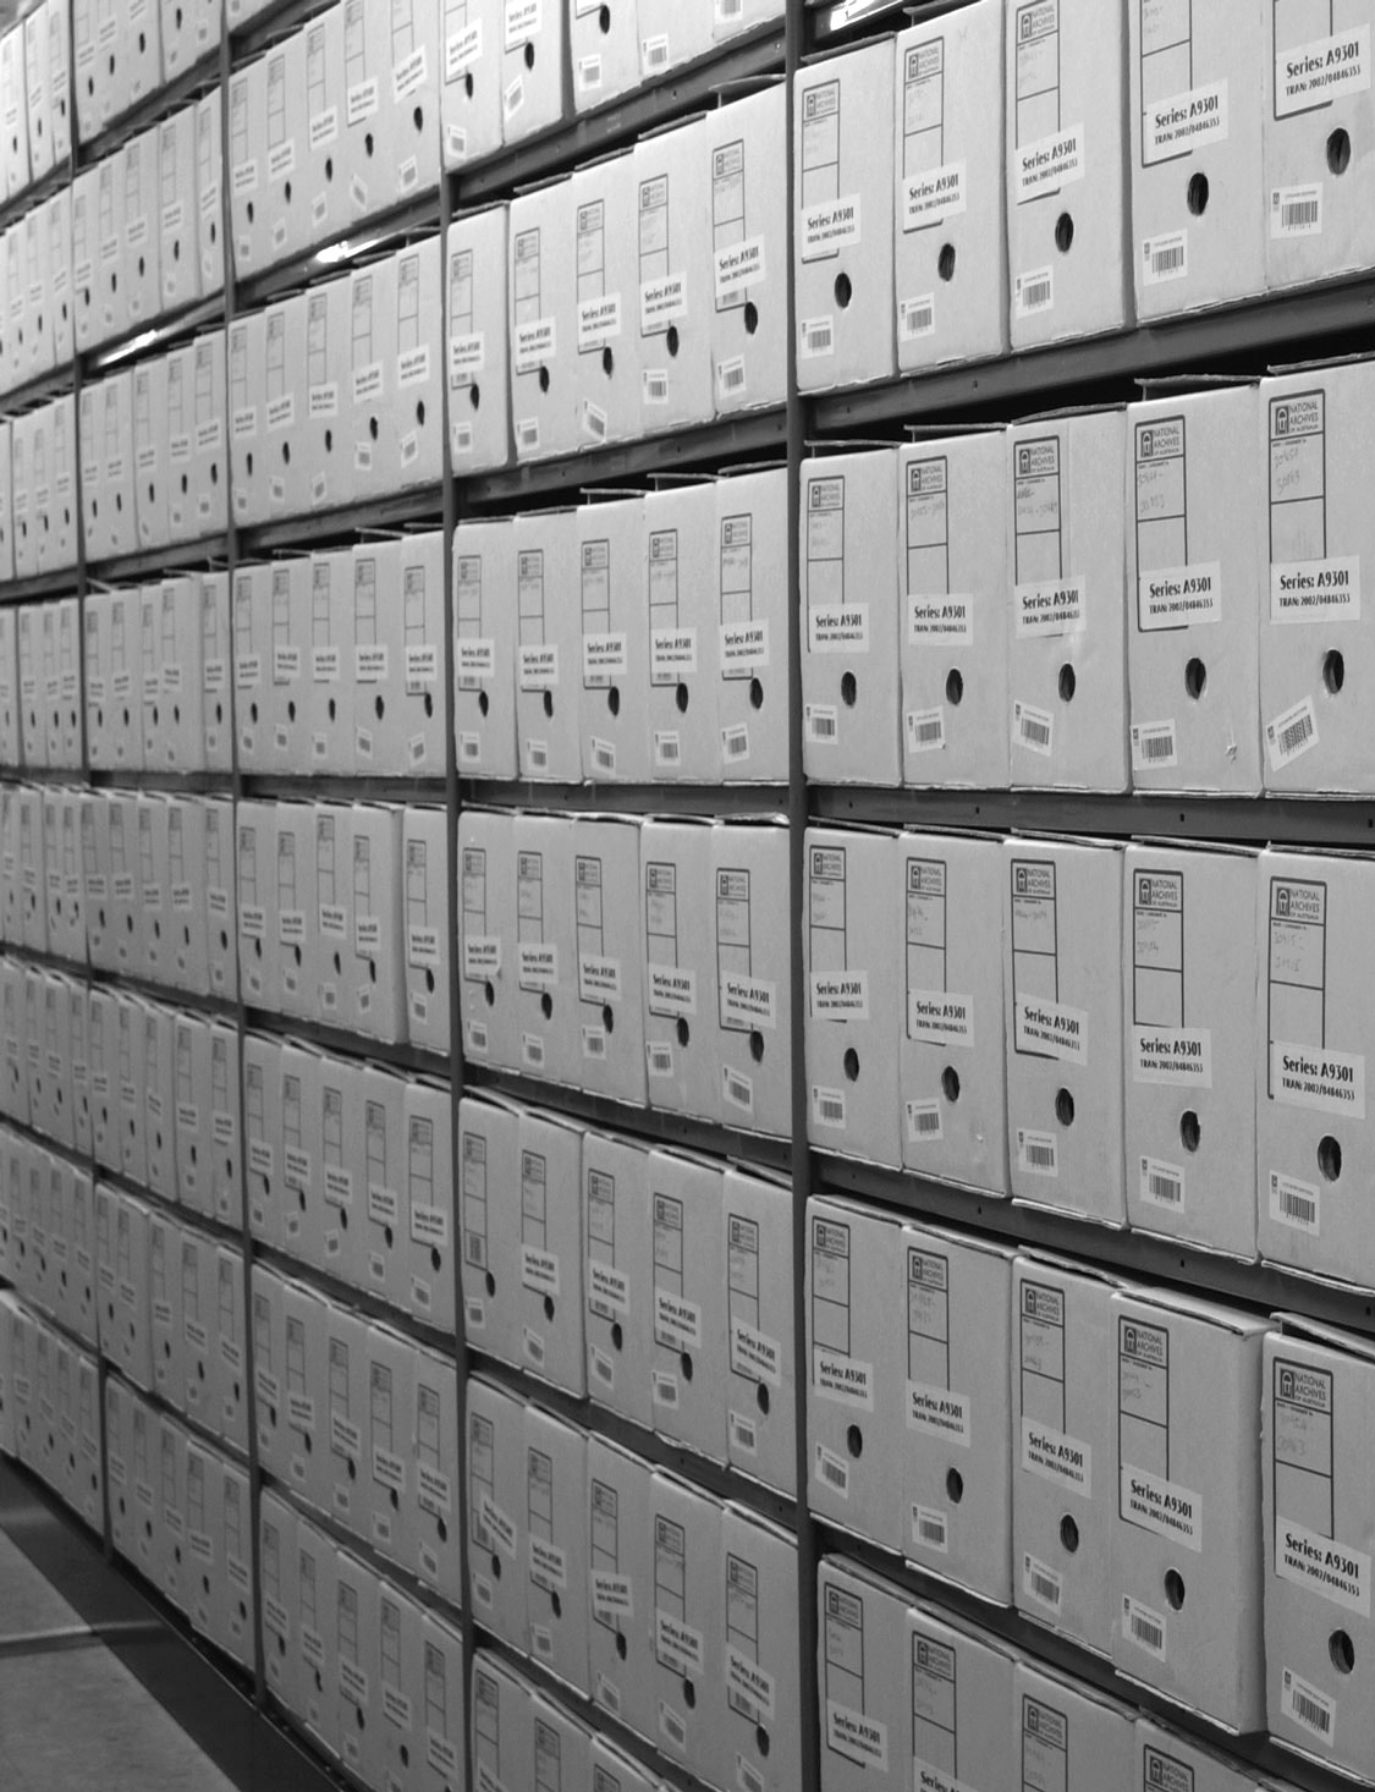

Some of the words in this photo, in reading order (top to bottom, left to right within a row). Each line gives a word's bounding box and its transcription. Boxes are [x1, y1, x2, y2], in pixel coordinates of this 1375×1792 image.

[1286, 55, 1323, 79] Series:
[1325, 41, 1359, 66] A9301
[1155, 107, 1187, 129] Series:
[1189, 94, 1219, 118] A9301
[1022, 151, 1050, 172] Series:
[1051, 138, 1077, 160] A9301
[1149, 580, 1181, 599] Series:
[1183, 576, 1212, 594] A9301
[1280, 572, 1315, 591] Series:
[1317, 570, 1349, 588] A9301
[1022, 593, 1051, 610] Series:
[1053, 589, 1079, 606] A9301
[1024, 1006, 1052, 1027] Series:
[1053, 1015, 1080, 1035] A9301
[1140, 1037, 1171, 1054] Series:
[1173, 1040, 1202, 1057] A9301
[1282, 1055, 1318, 1076] Series:
[1320, 1062, 1353, 1083] A9301
[1028, 1432, 1056, 1455] Series:
[1057, 1445, 1083, 1468] A9301
[1130, 1479, 1162, 1505] Series:
[1163, 1494, 1192, 1519] A9301
[1285, 1532, 1322, 1562] Series:
[1324, 1551, 1359, 1579] A9301
